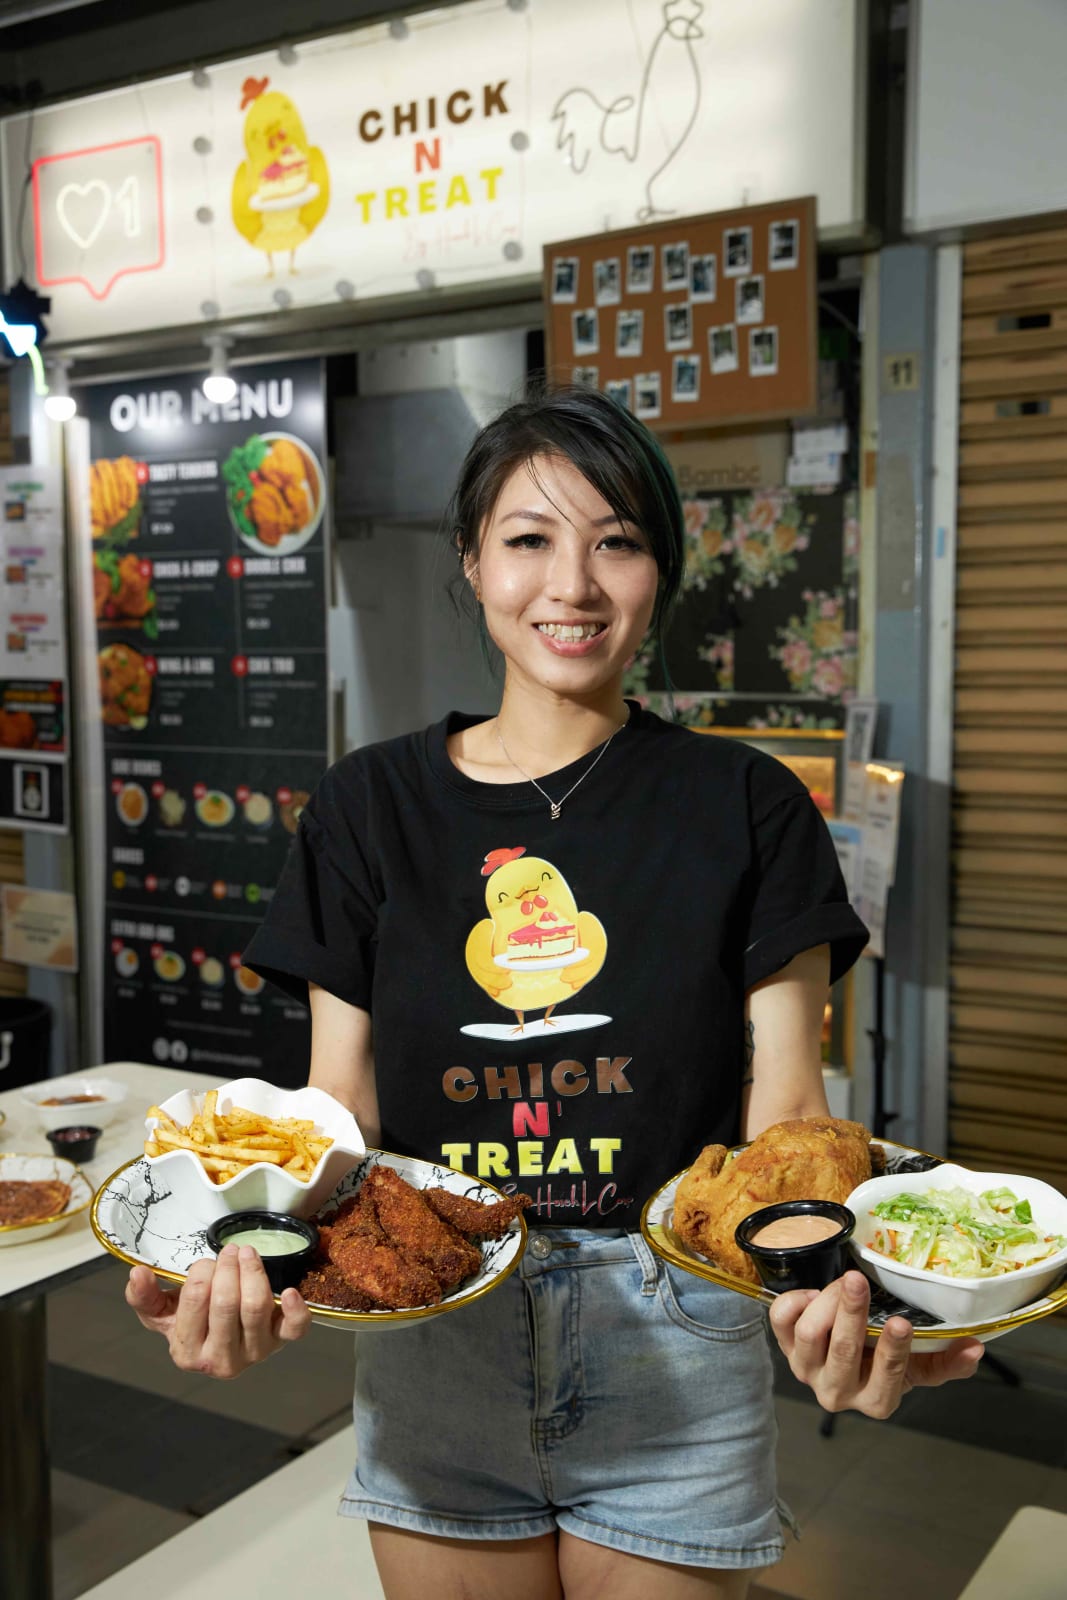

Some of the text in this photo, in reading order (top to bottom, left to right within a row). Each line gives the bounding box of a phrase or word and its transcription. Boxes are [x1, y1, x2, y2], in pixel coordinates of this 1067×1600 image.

[358, 79, 510, 144] CHICK
[115, 176, 141, 238] 1
[355, 166, 504, 224] TREAT
[109, 377, 294, 433] OUR MENU
[442, 1056, 634, 1103] CHICK
[513, 1101, 563, 1138] N'
[441, 1138, 622, 1178] TREAT
